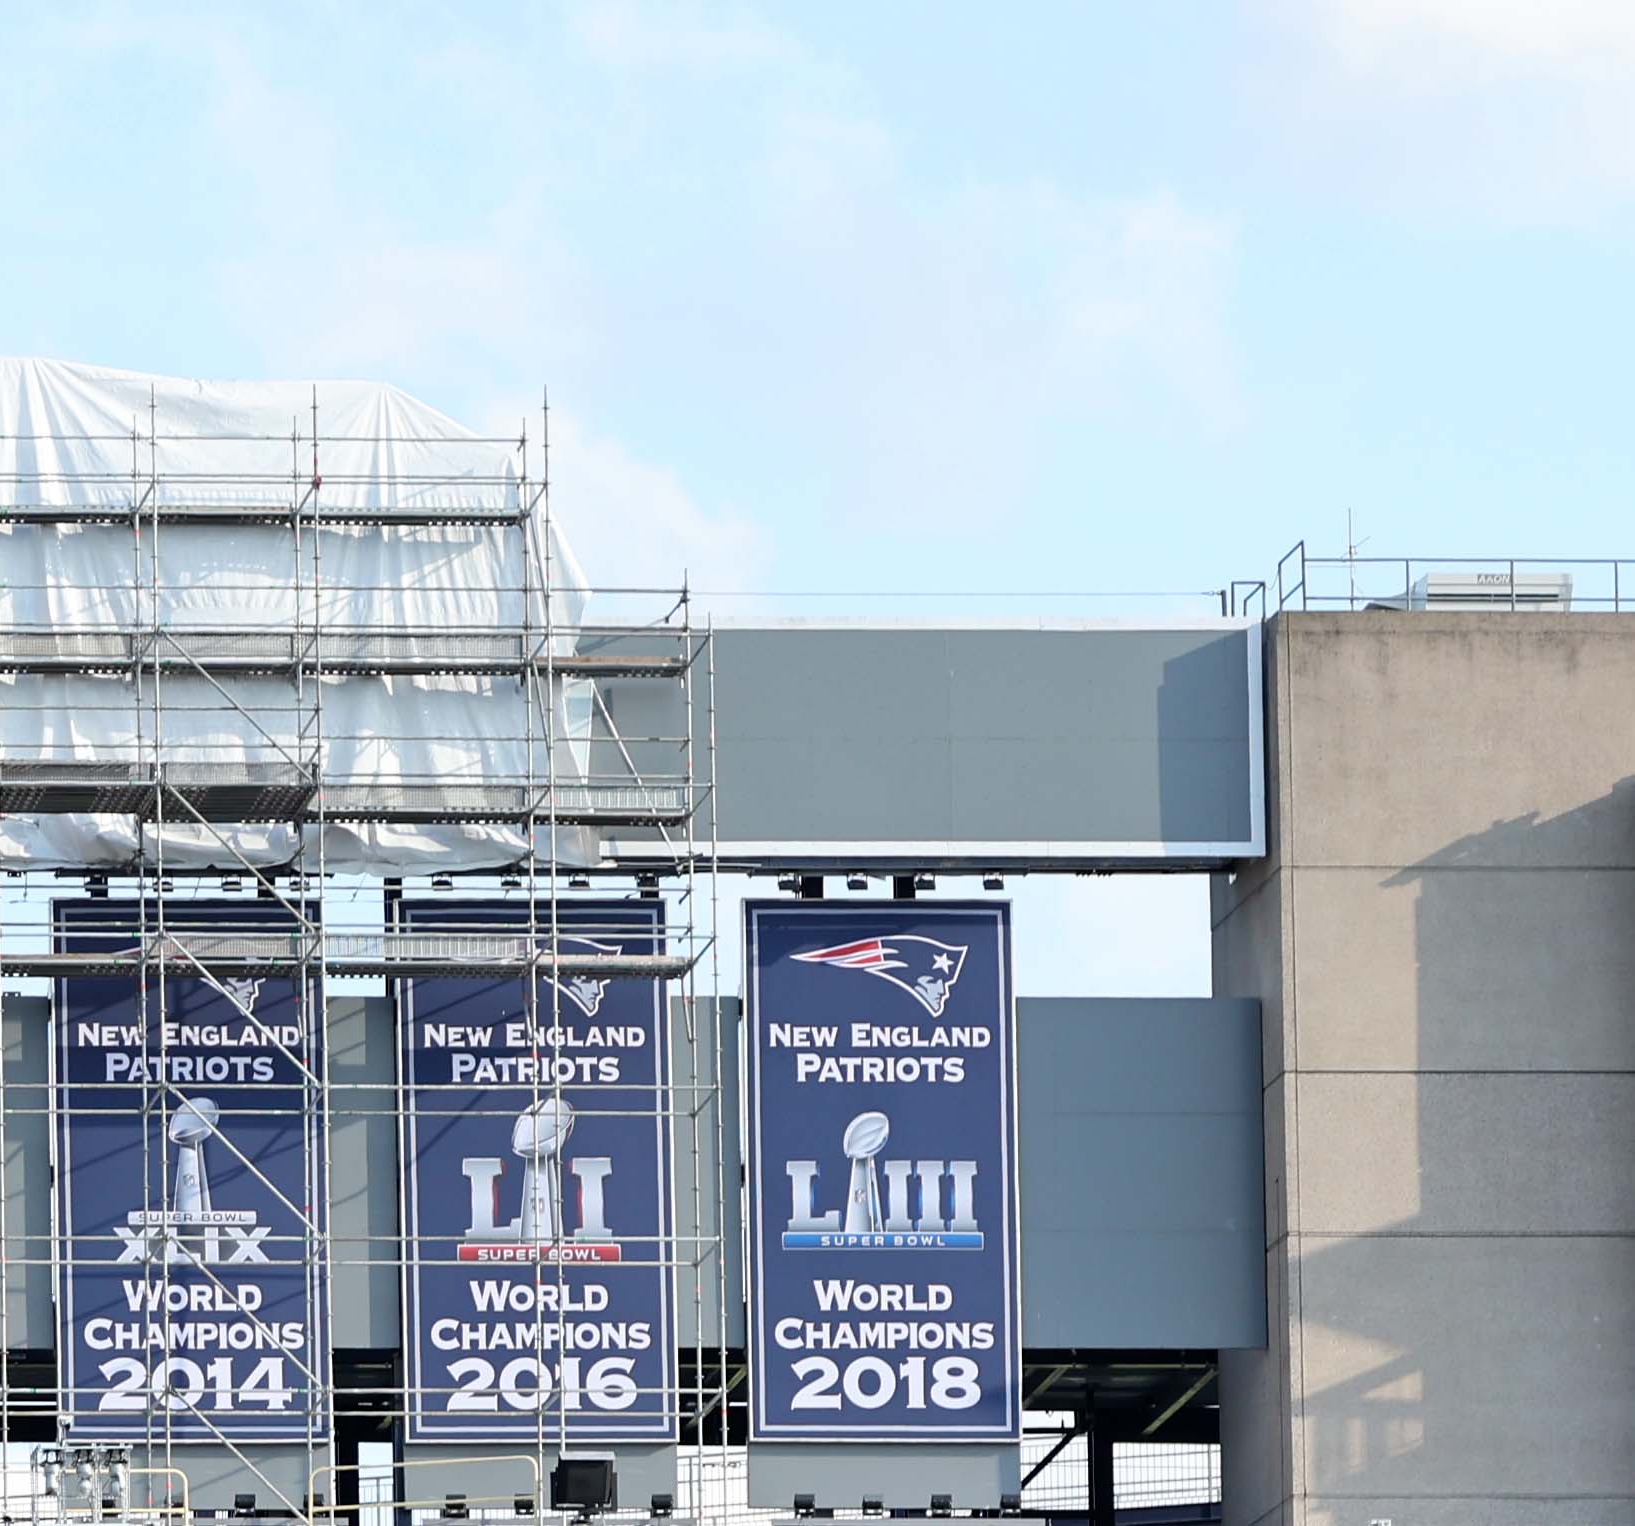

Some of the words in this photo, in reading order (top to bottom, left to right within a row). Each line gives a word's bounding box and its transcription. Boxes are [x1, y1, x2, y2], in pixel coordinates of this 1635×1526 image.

[1477, 574, 1510, 584] AAON
[163, 1022, 300, 1047] ENGLAND
[424, 1023, 493, 1047] NEW
[506, 1023, 645, 1047] ENGLAND
[769, 1023, 838, 1048] NEW
[851, 1023, 991, 1048] ENGLAND
[106, 1052, 274, 1082] PATRIOTS
[452, 1053, 620, 1083] PATRIOTS
[797, 1053, 965, 1083] PATRIOTS
[201, 1212, 247, 1223] BOWL
[113, 1226, 272, 1263] XLIX
[821, 1236, 884, 1246] SUPER
[894, 1236, 946, 1246] BOWL
[122, 1280, 262, 1312] WORLD
[469, 1280, 608, 1312] WORLD
[813, 1279, 952, 1311] WORLD
[84, 1318, 304, 1350] CHAMPIONS
[430, 1318, 651, 1350] CHAMPIONS
[774, 1317, 995, 1349] CHAMPIONS
[98, 1357, 292, 1411] 2014
[446, 1357, 638, 1412] 2016
[790, 1356, 982, 1411] 2018
